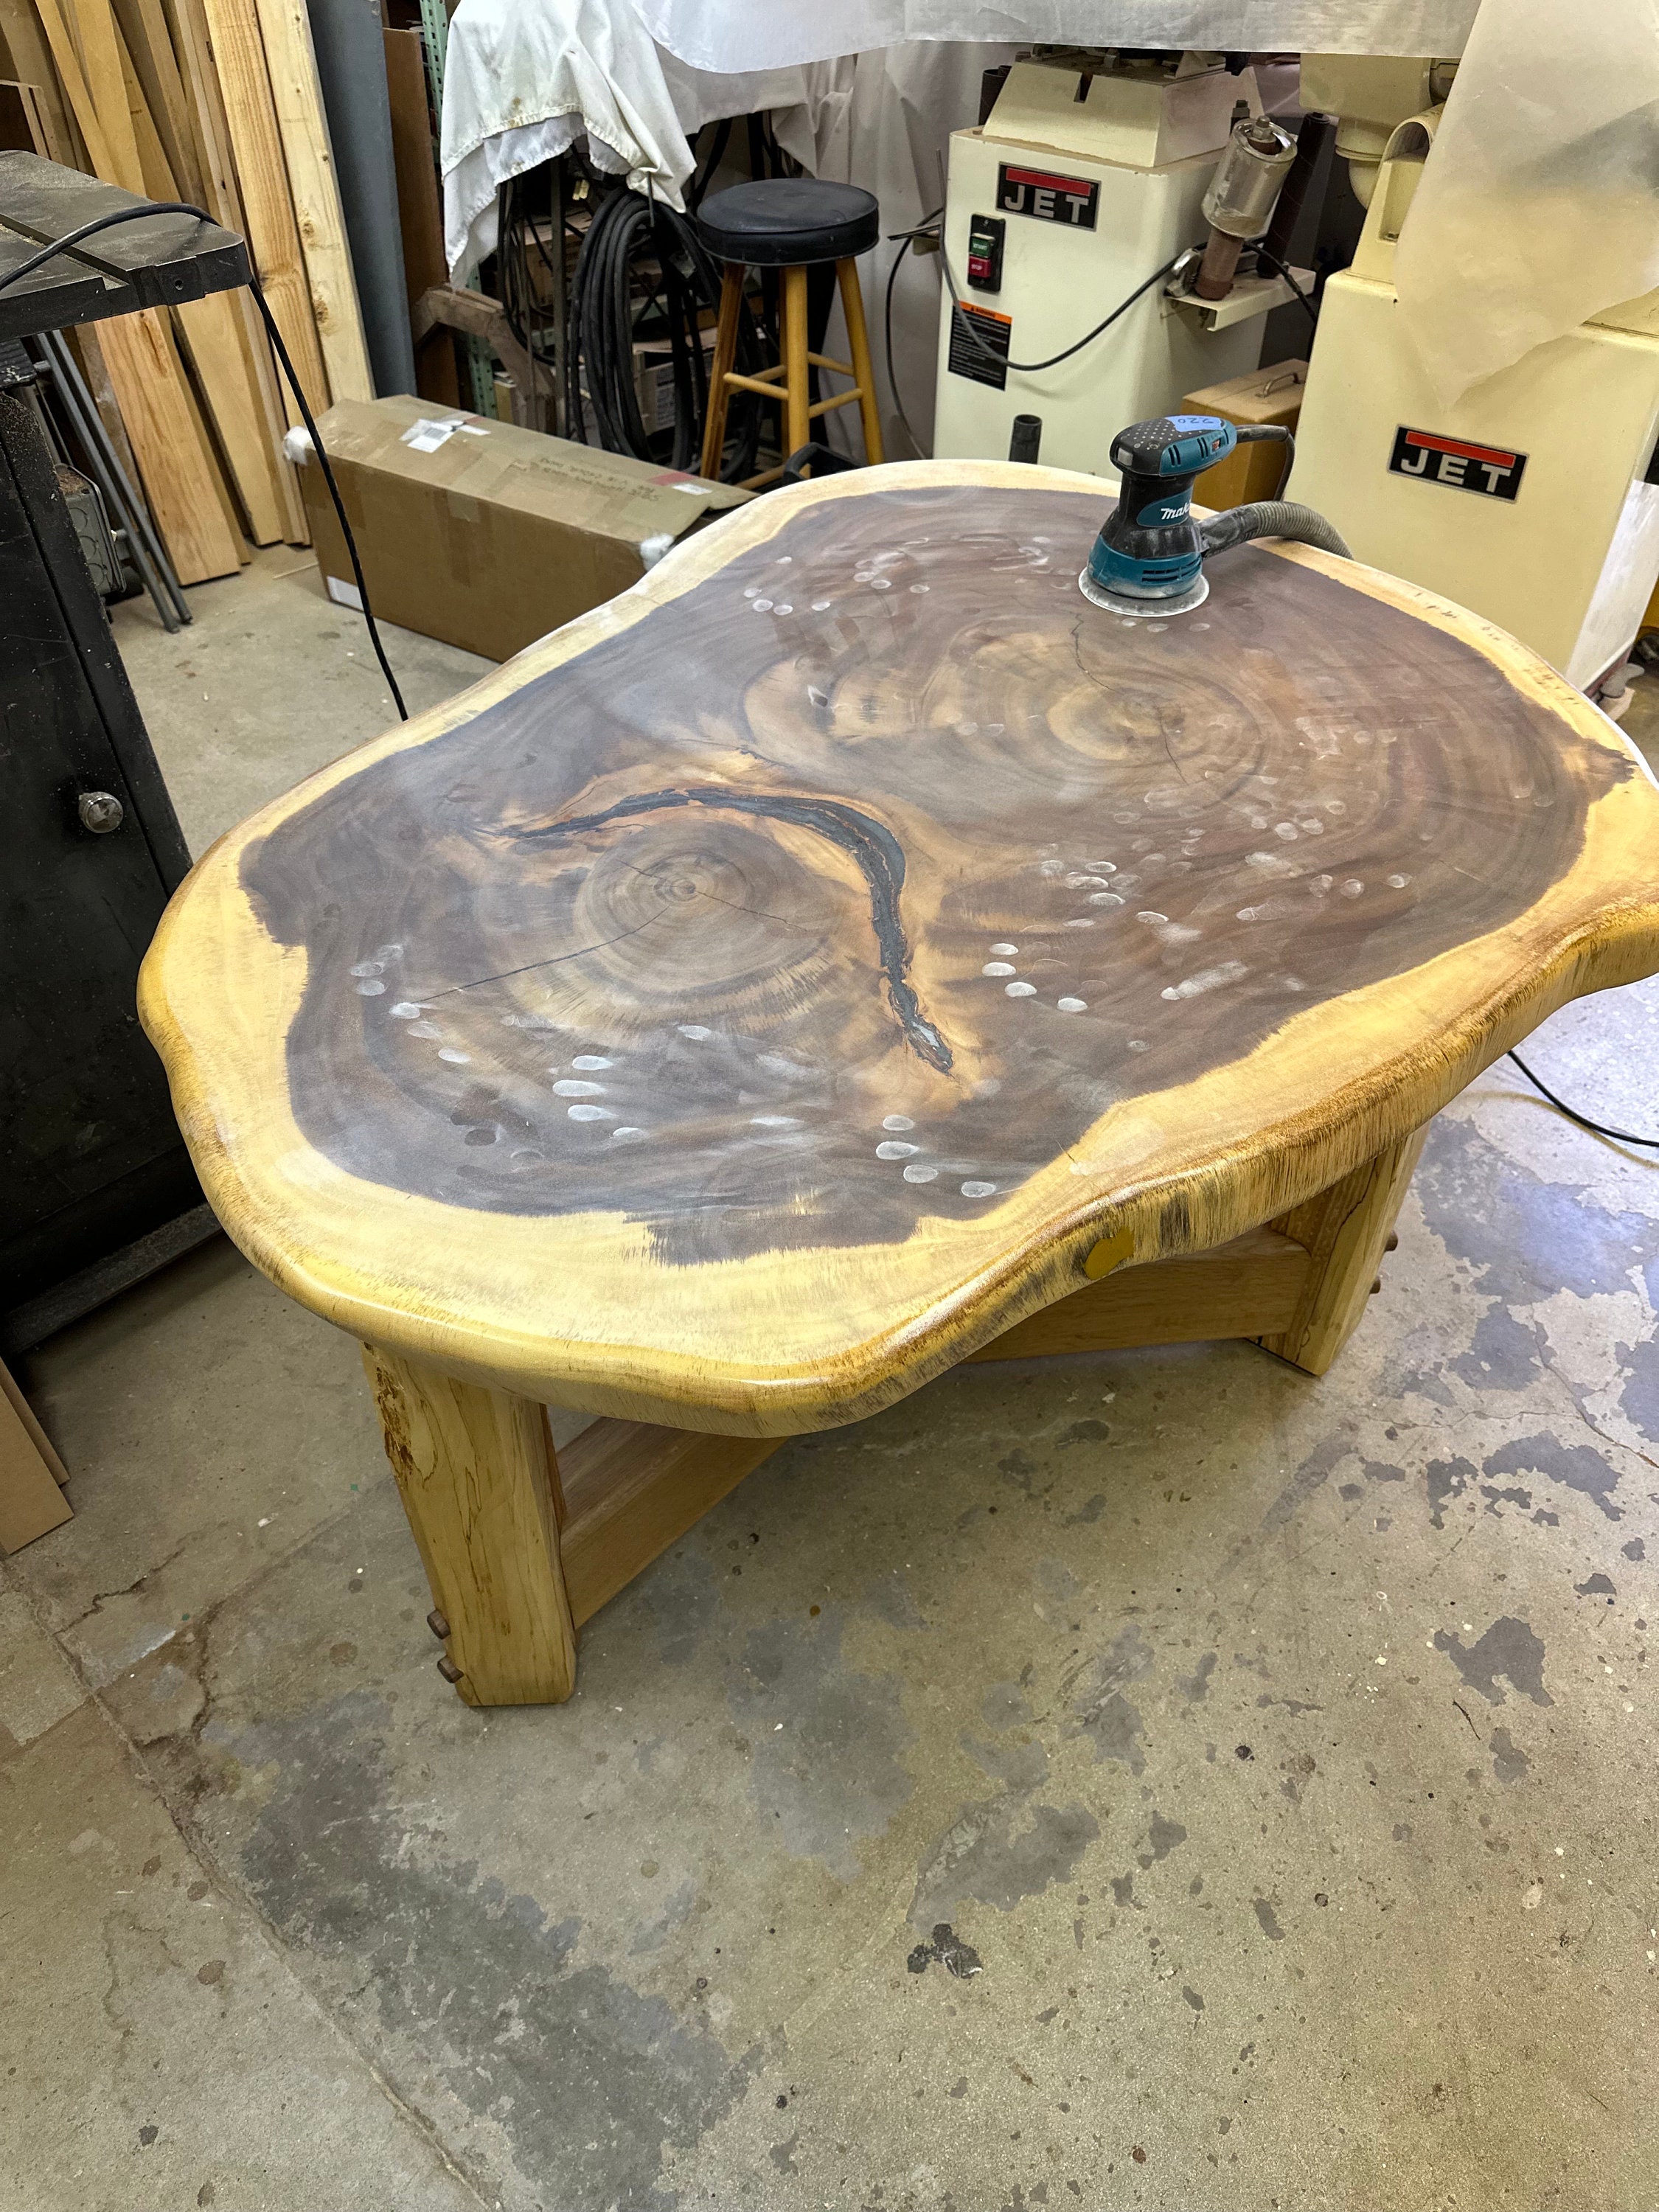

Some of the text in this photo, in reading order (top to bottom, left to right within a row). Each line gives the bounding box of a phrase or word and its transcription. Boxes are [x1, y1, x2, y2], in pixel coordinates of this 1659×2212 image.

[1004, 185, 1089, 223] JET
[1400, 449, 1512, 493] JET
[1161, 502, 1190, 520] Mak
